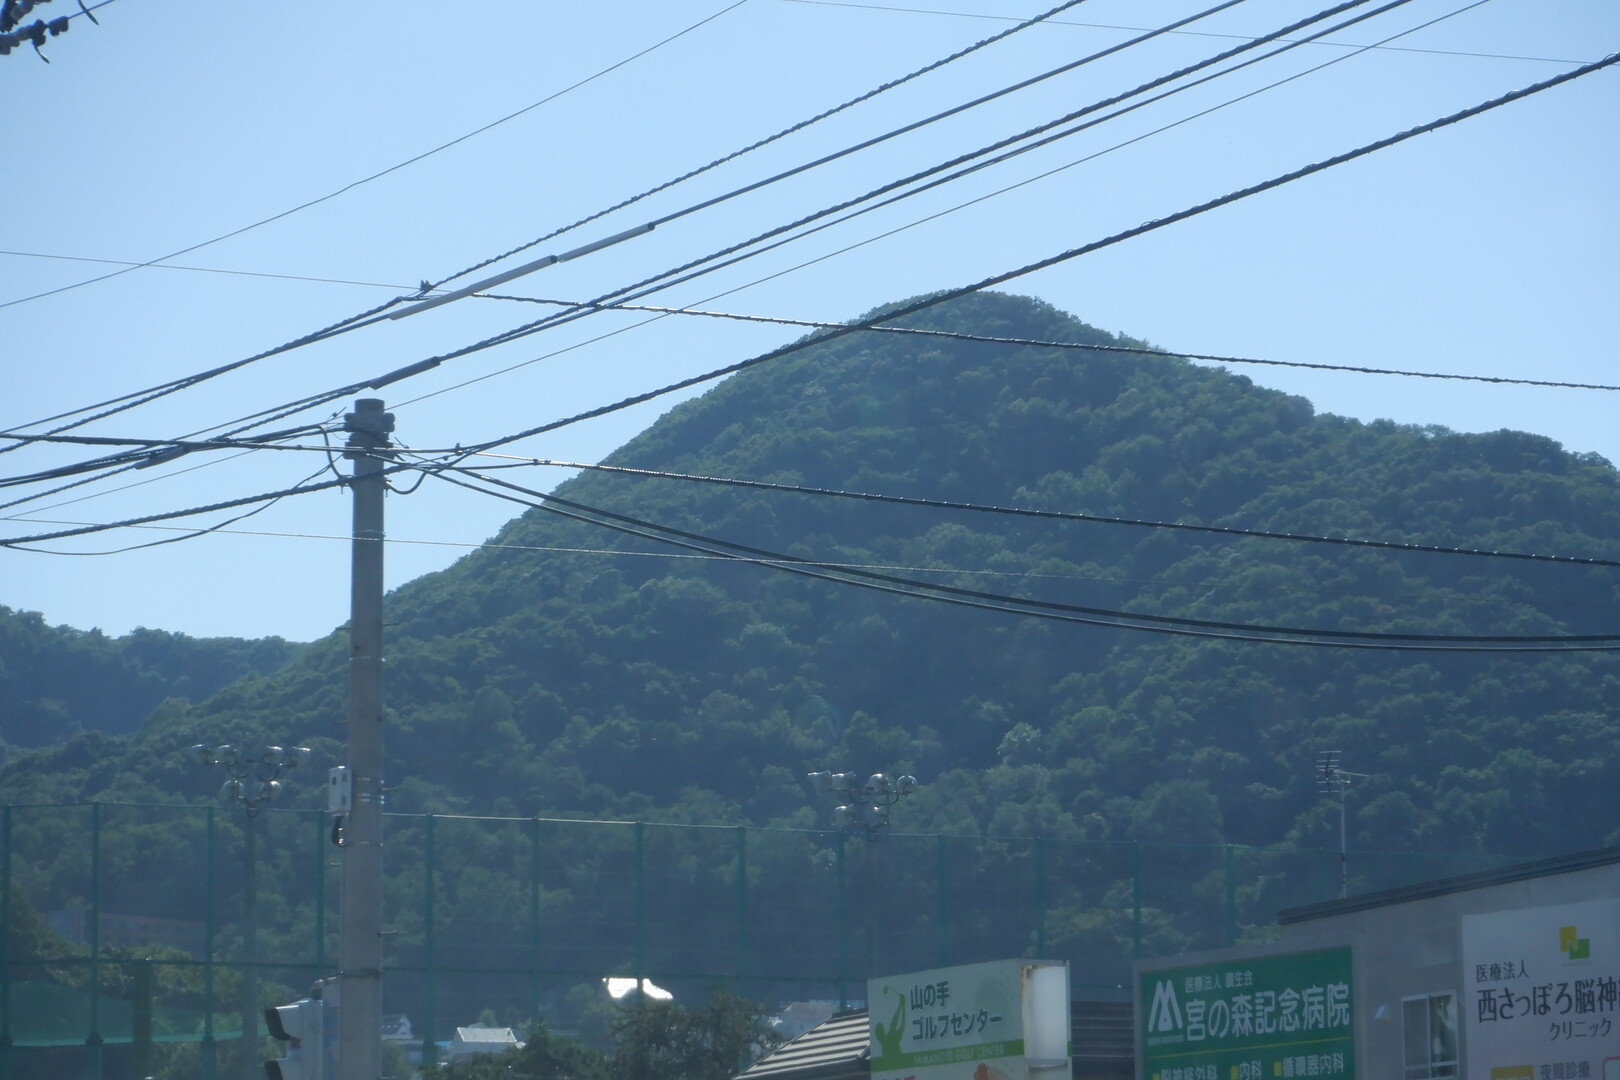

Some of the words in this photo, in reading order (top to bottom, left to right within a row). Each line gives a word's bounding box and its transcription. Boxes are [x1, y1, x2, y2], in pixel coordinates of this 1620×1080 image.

[1185, 973, 1222, 993] 医療法人
[1476, 960, 1530, 983] 医療法人
[910, 980, 950, 1011] 山の手
[1477, 976, 1620, 1023] 西さっぽろ脳神
[1186, 981, 1350, 1041] 宮の森記念病院
[912, 1008, 1002, 1040] ゴルフセンター
[1549, 1018, 1612, 1041] クリニック
[913, 1050, 953, 1064] YAMANOTE
[956, 1048, 974, 1060] GOLF
[977, 1044, 1005, 1058] CENTER
[1540, 1061, 1591, 1080] 夜間診療
